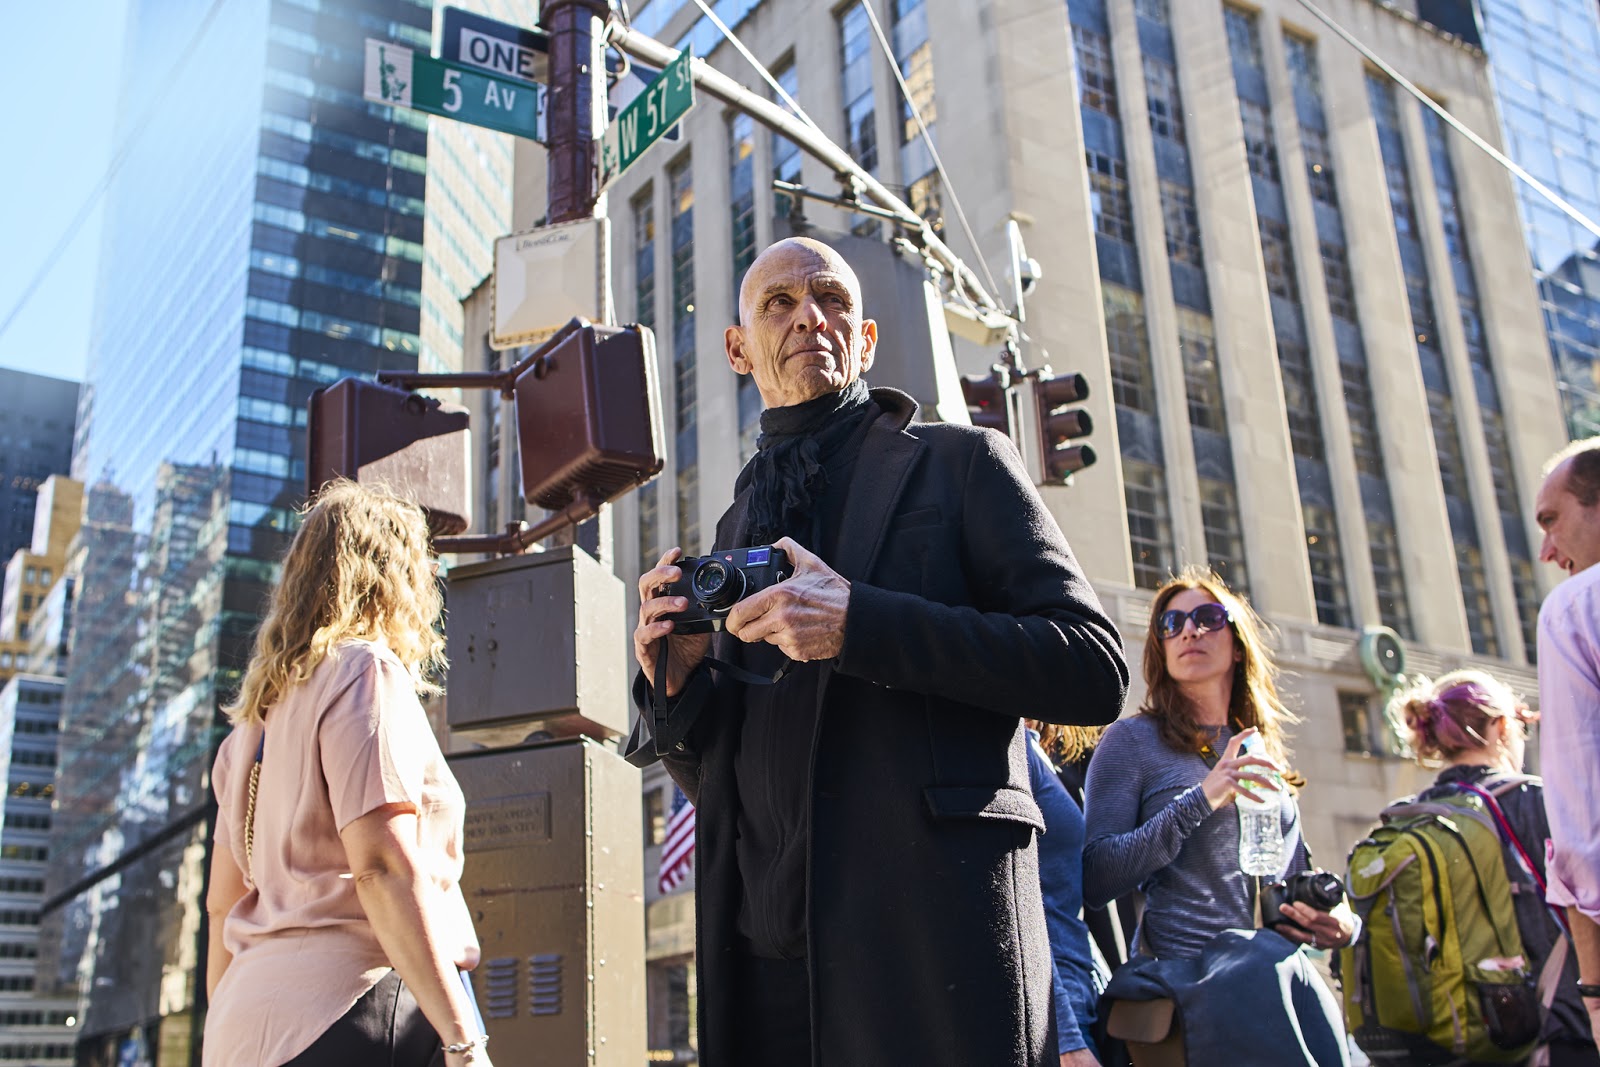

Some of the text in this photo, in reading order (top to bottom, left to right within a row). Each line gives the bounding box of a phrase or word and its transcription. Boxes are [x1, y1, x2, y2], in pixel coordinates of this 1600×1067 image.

[469, 37, 535, 79] ONE
[442, 68, 463, 112] 5
[621, 106, 638, 160] W
[647, 77, 669, 137] 57
